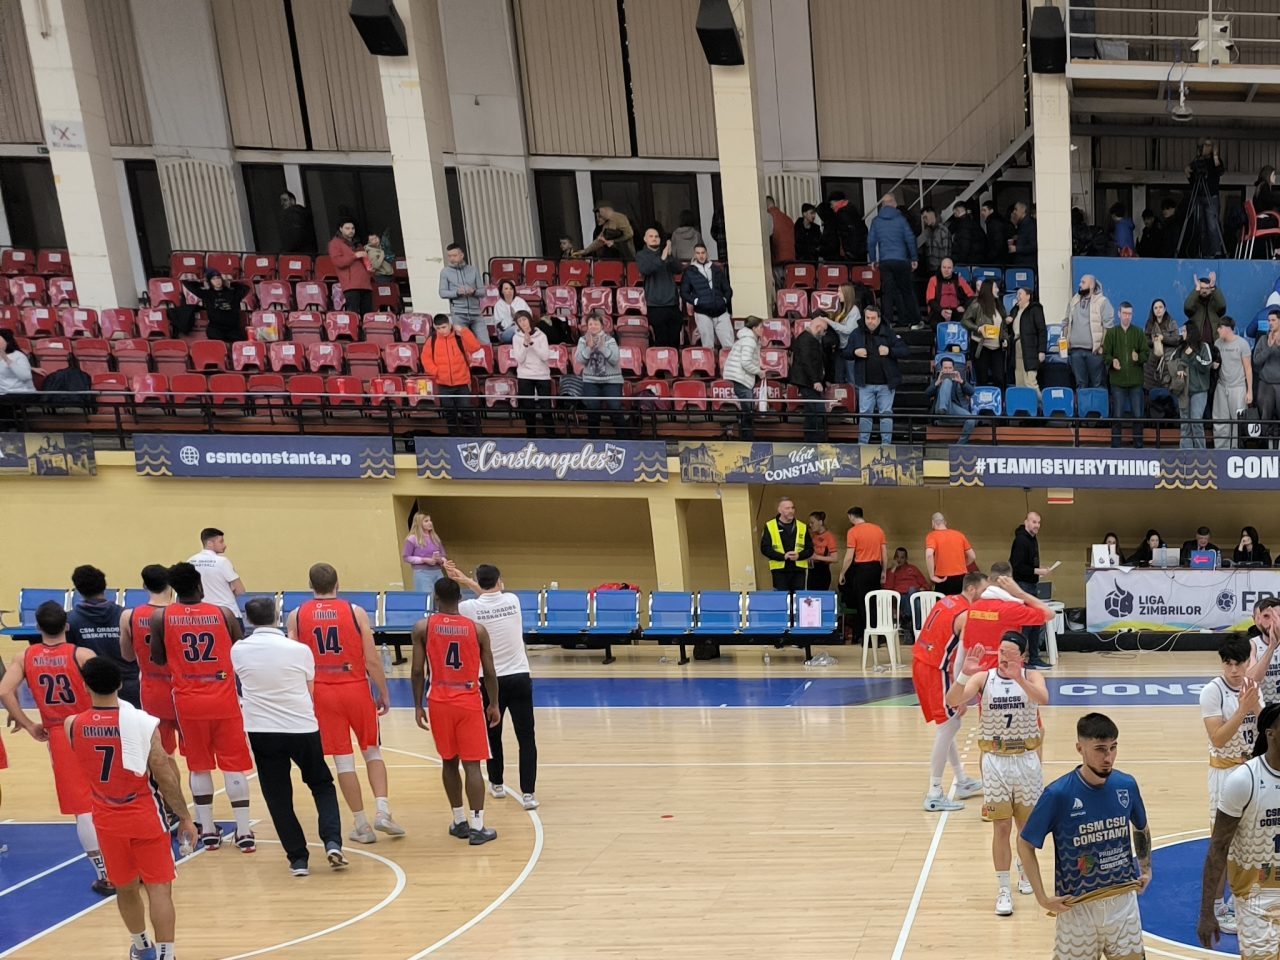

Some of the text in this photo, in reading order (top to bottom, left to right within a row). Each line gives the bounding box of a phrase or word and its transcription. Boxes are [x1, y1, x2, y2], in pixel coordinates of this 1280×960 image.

[713, 387, 738, 399] PRES
[205, 451, 352, 466] csmconstanta.ro
[479, 440, 607, 479] Constangeles
[975, 457, 1160, 477] #TEAMISEVERYTHING
[1139, 595, 1165, 605] LIGA
[1139, 605, 1201, 615] ZIMBRILOR
[181, 632, 218, 662] 32
[313, 625, 342, 655] 14
[445, 641, 463, 671] 4
[38, 673, 76, 705] 23
[1004, 714, 1013, 728] 7
[83, 725, 121, 738] BROWN
[94, 745, 115, 783] 7
[1078, 816, 1126, 834] CSM CSU
